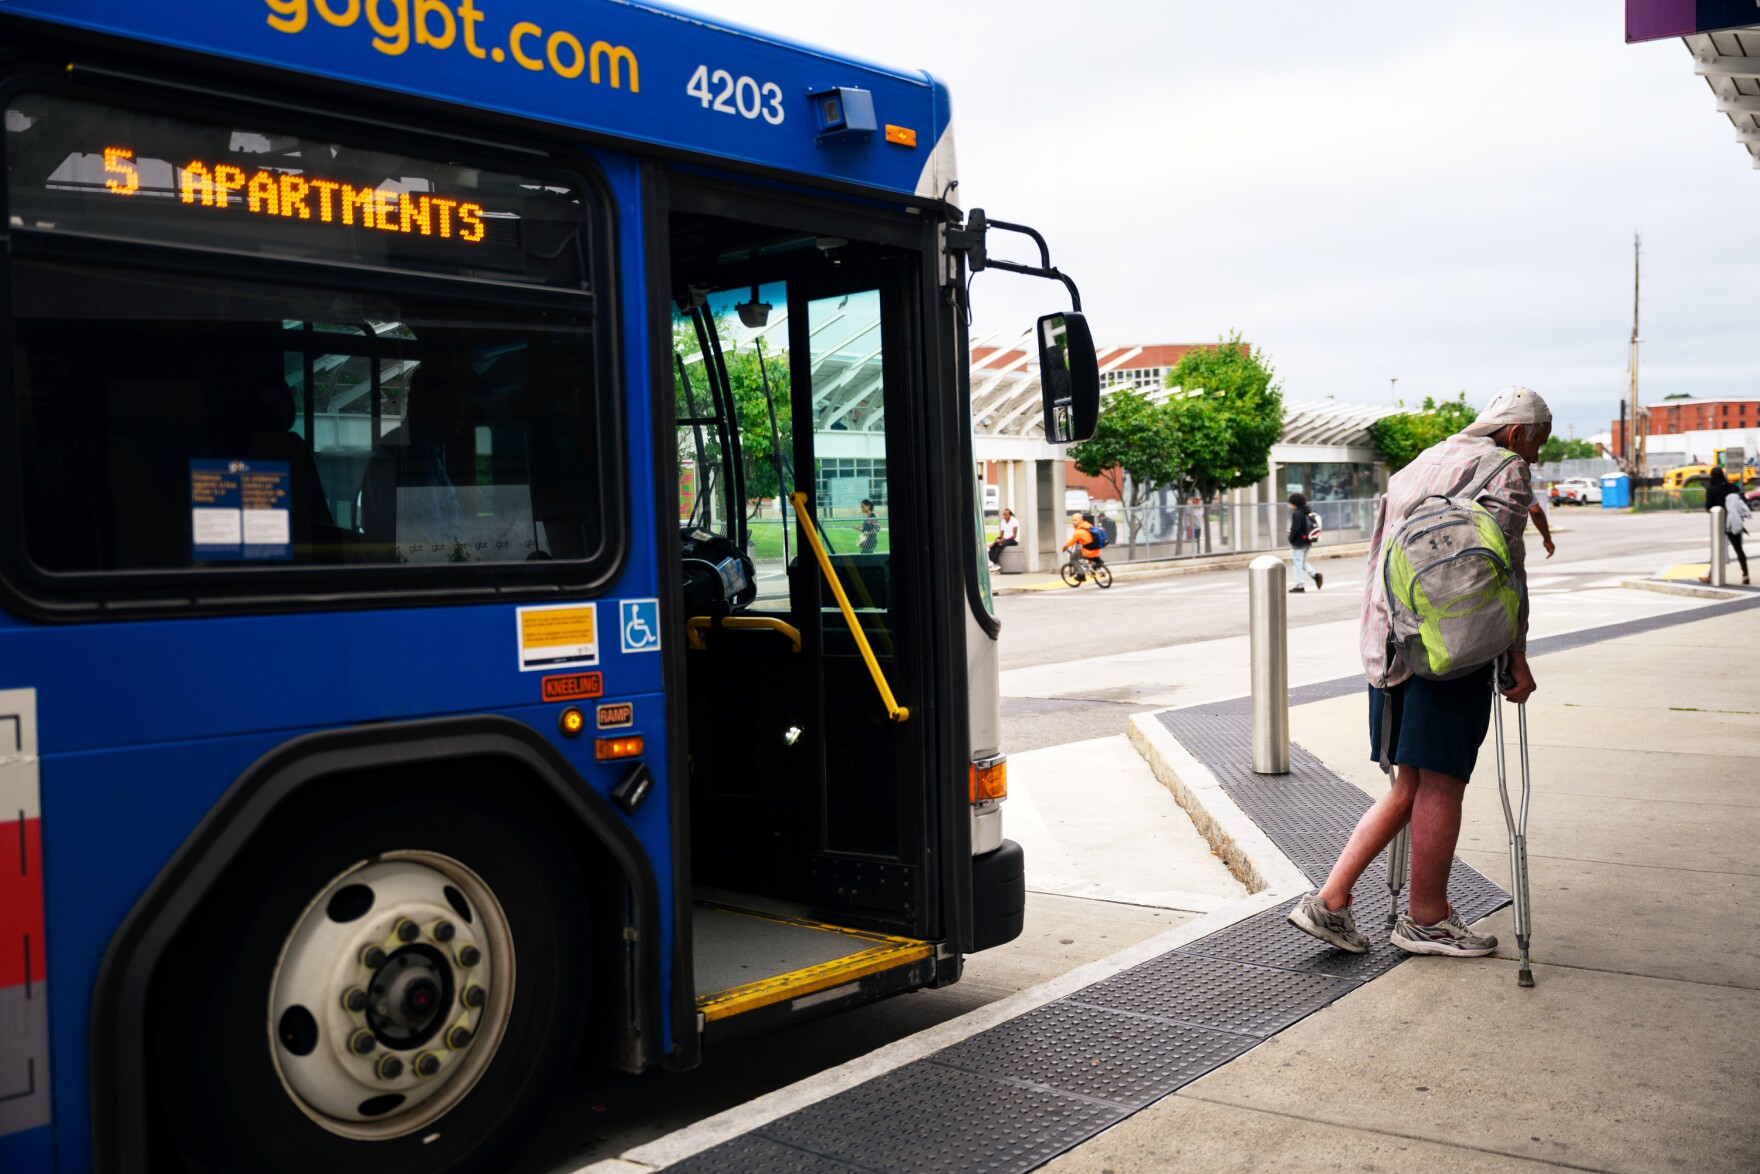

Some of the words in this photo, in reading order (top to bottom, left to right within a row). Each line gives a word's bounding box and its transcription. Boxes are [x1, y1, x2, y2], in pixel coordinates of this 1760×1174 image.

[686, 64, 785, 125] 4203
[104, 147, 138, 195] 5
[181, 160, 484, 242] APARTMENTS
[546, 676, 598, 695] KNEELING
[600, 705, 630, 724] RAMP
